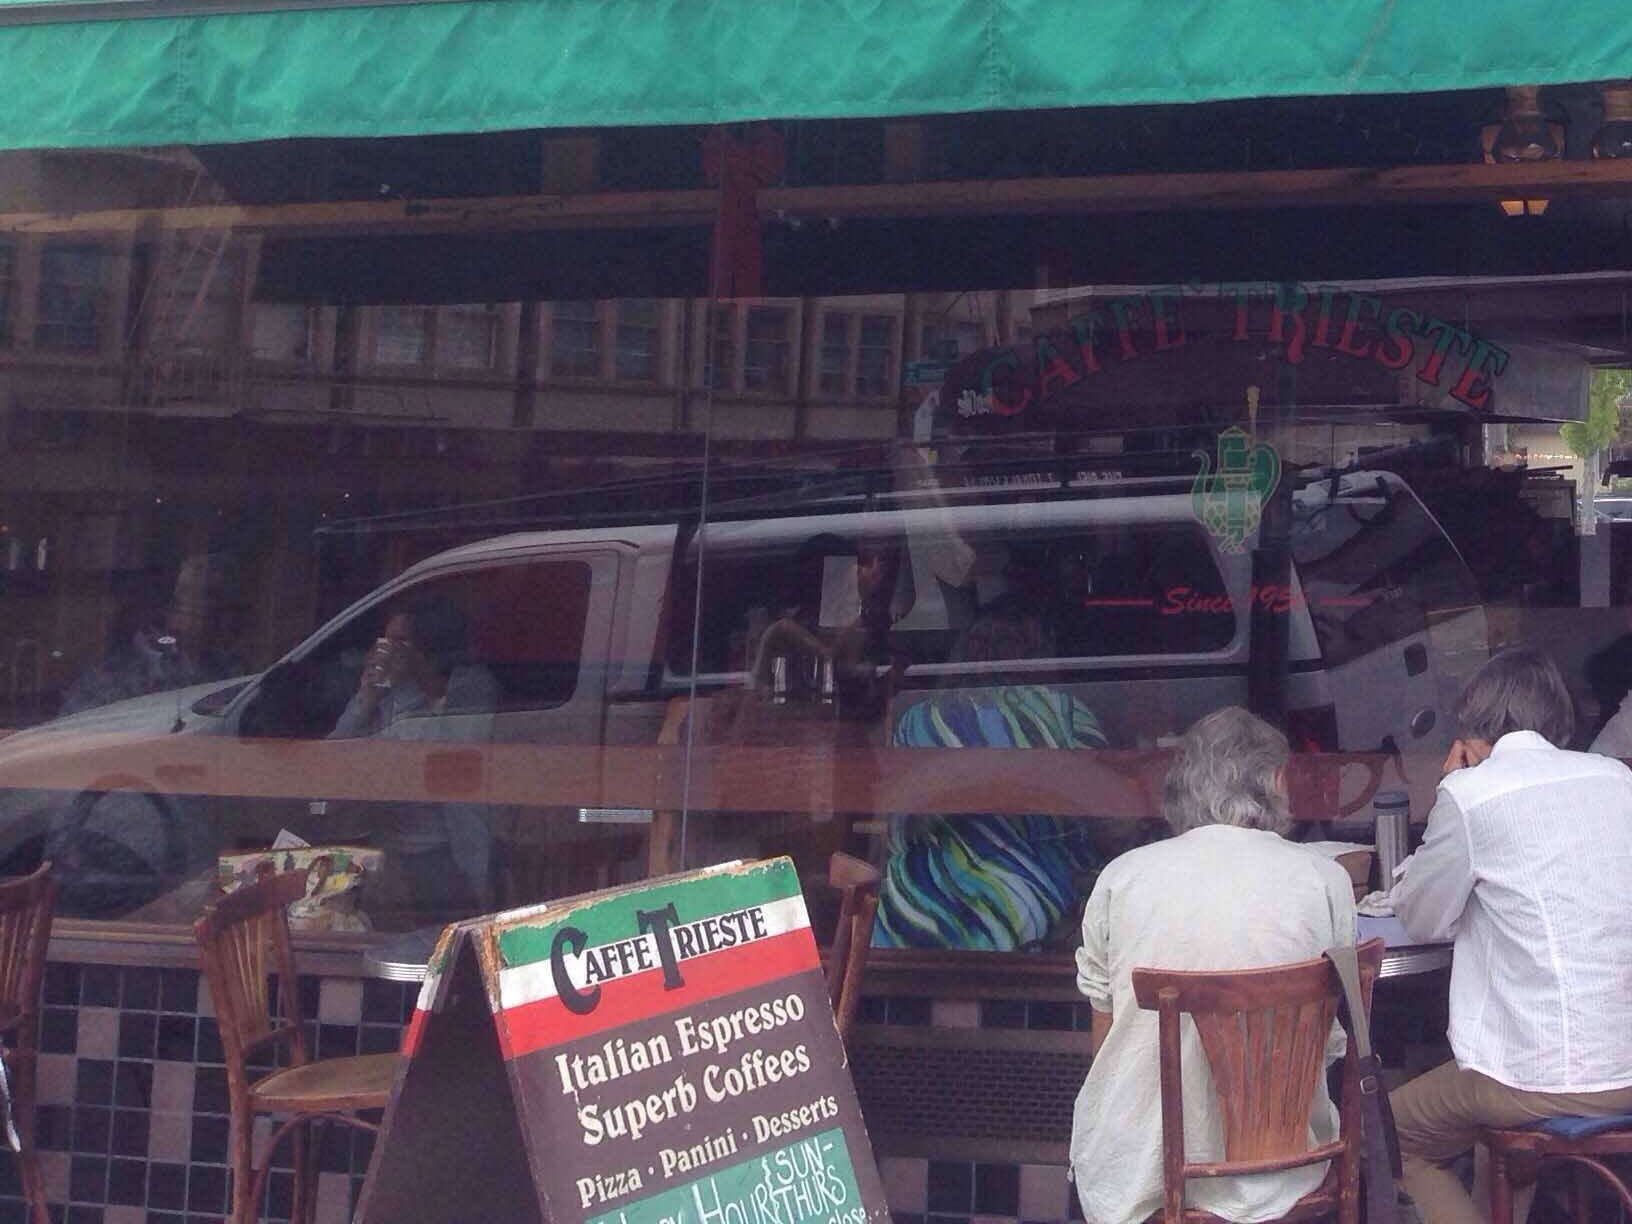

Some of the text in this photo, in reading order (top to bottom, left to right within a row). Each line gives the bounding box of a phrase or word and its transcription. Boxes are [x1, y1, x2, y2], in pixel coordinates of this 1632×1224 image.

[1216, 280, 1511, 410] TRIESTE
[550, 902, 768, 1016] CAFFE TRIESTE
[555, 993, 805, 1095] Italian Espresso
[580, 1044, 811, 1146] Superb Coffees
[575, 1095, 839, 1209] Pizza Panini Desserts
[772, 1163, 847, 1224] THURS
